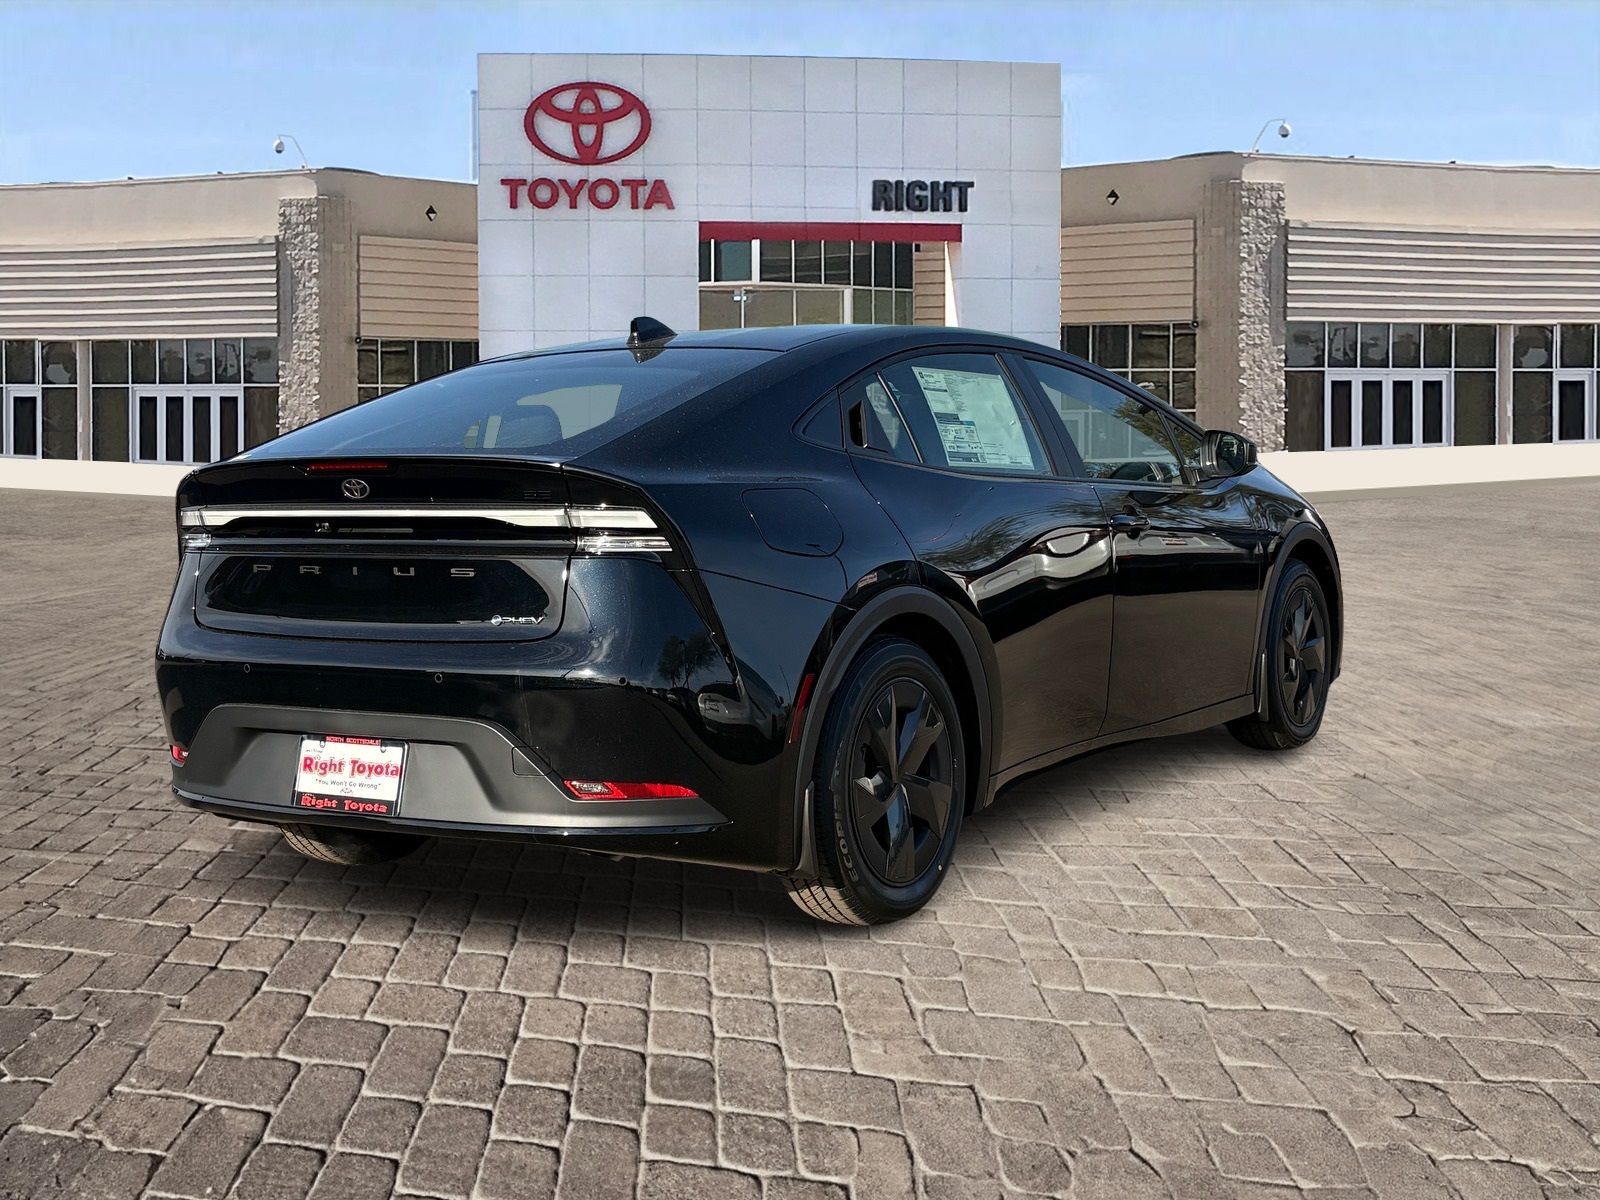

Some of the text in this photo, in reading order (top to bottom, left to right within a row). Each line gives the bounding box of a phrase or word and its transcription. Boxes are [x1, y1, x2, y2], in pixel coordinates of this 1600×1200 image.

[500, 178, 675, 210] TOYOTA
[871, 179, 974, 213] RIGHT
[253, 564, 475, 577] PRIUS
[502, 616, 544, 625] PHEV
[303, 756, 399, 777] Right Toyota
[301, 796, 388, 813] Right Toyota
